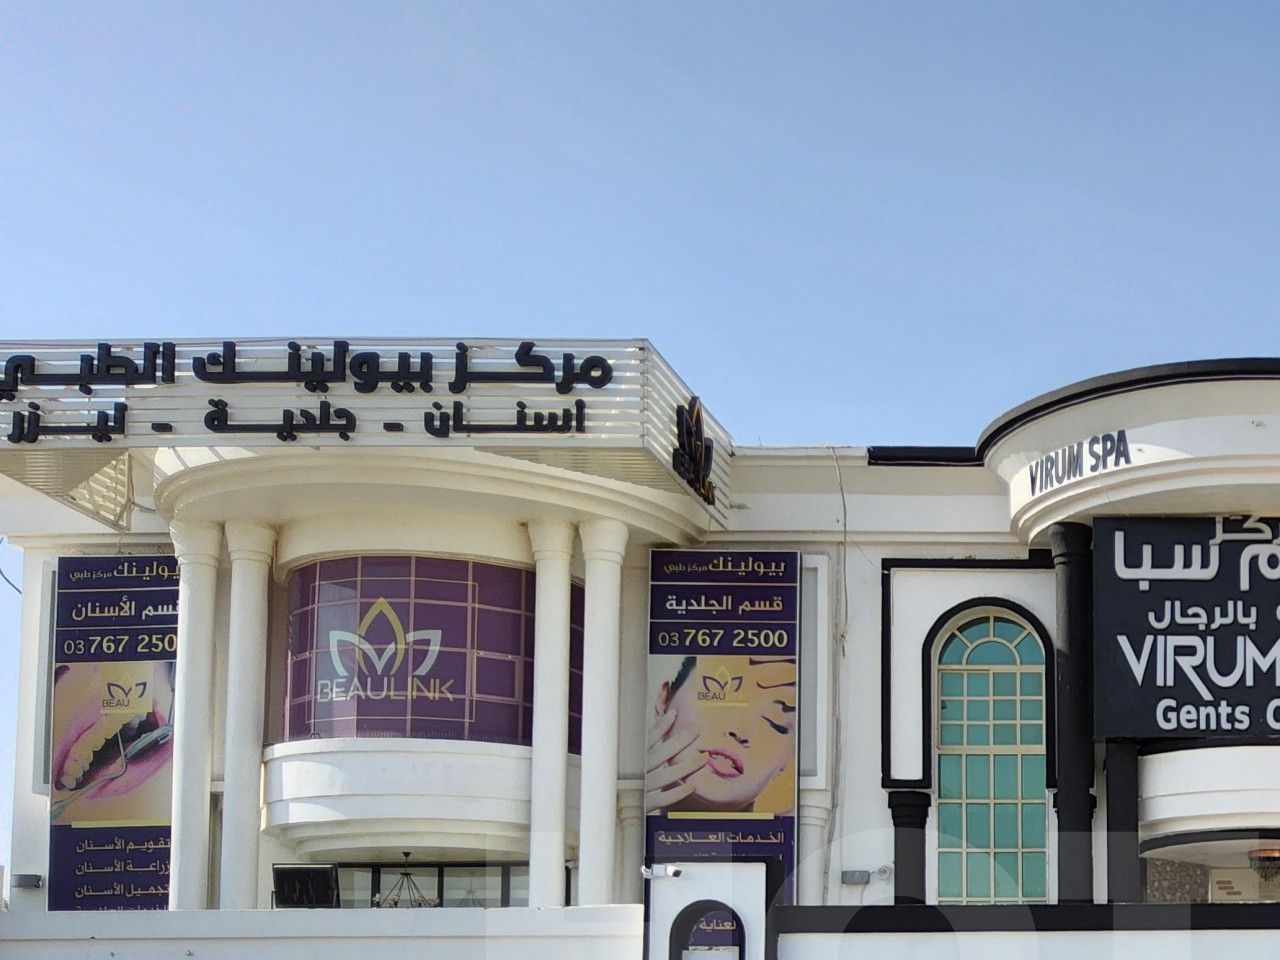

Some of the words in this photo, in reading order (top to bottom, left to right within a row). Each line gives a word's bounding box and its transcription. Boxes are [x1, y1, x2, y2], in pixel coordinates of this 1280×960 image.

[192, 340, 433, 394] بيولينك
[449, 341, 613, 395] مركز
[7, 401, 128, 443] ليزر
[204, 399, 357, 442] جلدية
[424, 399, 586, 438] اسنان
[1029, 443, 1084, 497] VIRUM
[1088, 430, 1131, 473] SPA
[113, 561, 180, 580] يولينك
[709, 556, 786, 577] بيولينك
[1114, 530, 1221, 593] سبا
[72, 595, 136, 621] الأسنان
[665, 594, 732, 615] الجلدية
[738, 596, 783, 615] قسم
[1147, 600, 1258, 631] بالرجال
[64, 640, 85, 655] 03
[89, 635, 129, 654] 767
[137, 633, 177, 653] 250
[658, 632, 680, 646] 03
[683, 629, 724, 647] 767
[732, 629, 788, 648] 2500
[317, 677, 454, 702] BEAULINK
[1155, 699, 1250, 731] Gents
[76, 836, 125, 853] الأسنان
[658, 830, 725, 846] العلاجية
[726, 830, 785, 845] الخدمات
[75, 859, 125, 875] الأسنان
[126, 860, 171, 875] زراعة
[75, 882, 124, 899] الأسنان
[699, 918, 737, 932] لعناية
